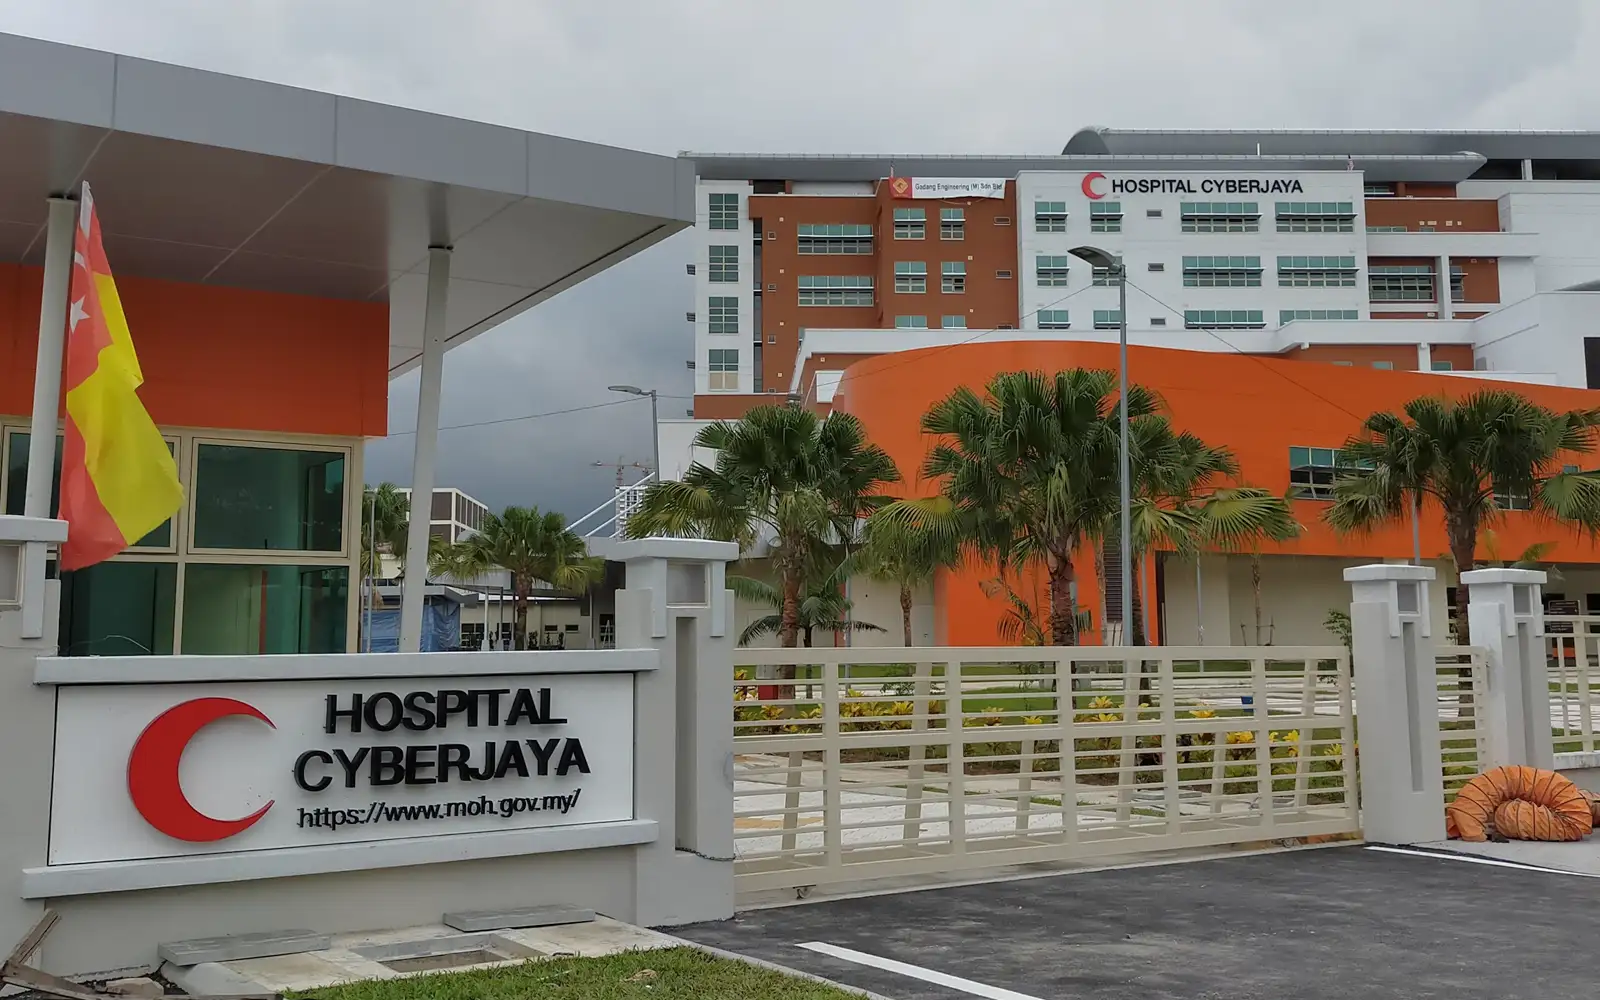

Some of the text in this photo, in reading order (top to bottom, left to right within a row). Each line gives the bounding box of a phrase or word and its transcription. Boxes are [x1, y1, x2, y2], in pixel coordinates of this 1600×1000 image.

[915, 183, 936, 191] Gadang
[937, 183, 970, 191] Engineering
[1112, 179, 1303, 193] HOSPITAL CYBERJAYA
[324, 688, 568, 734] HOSPITAL
[292, 738, 591, 792] CYBERJAYA
[297, 788, 582, 831] https://www.moh.gov.my/
